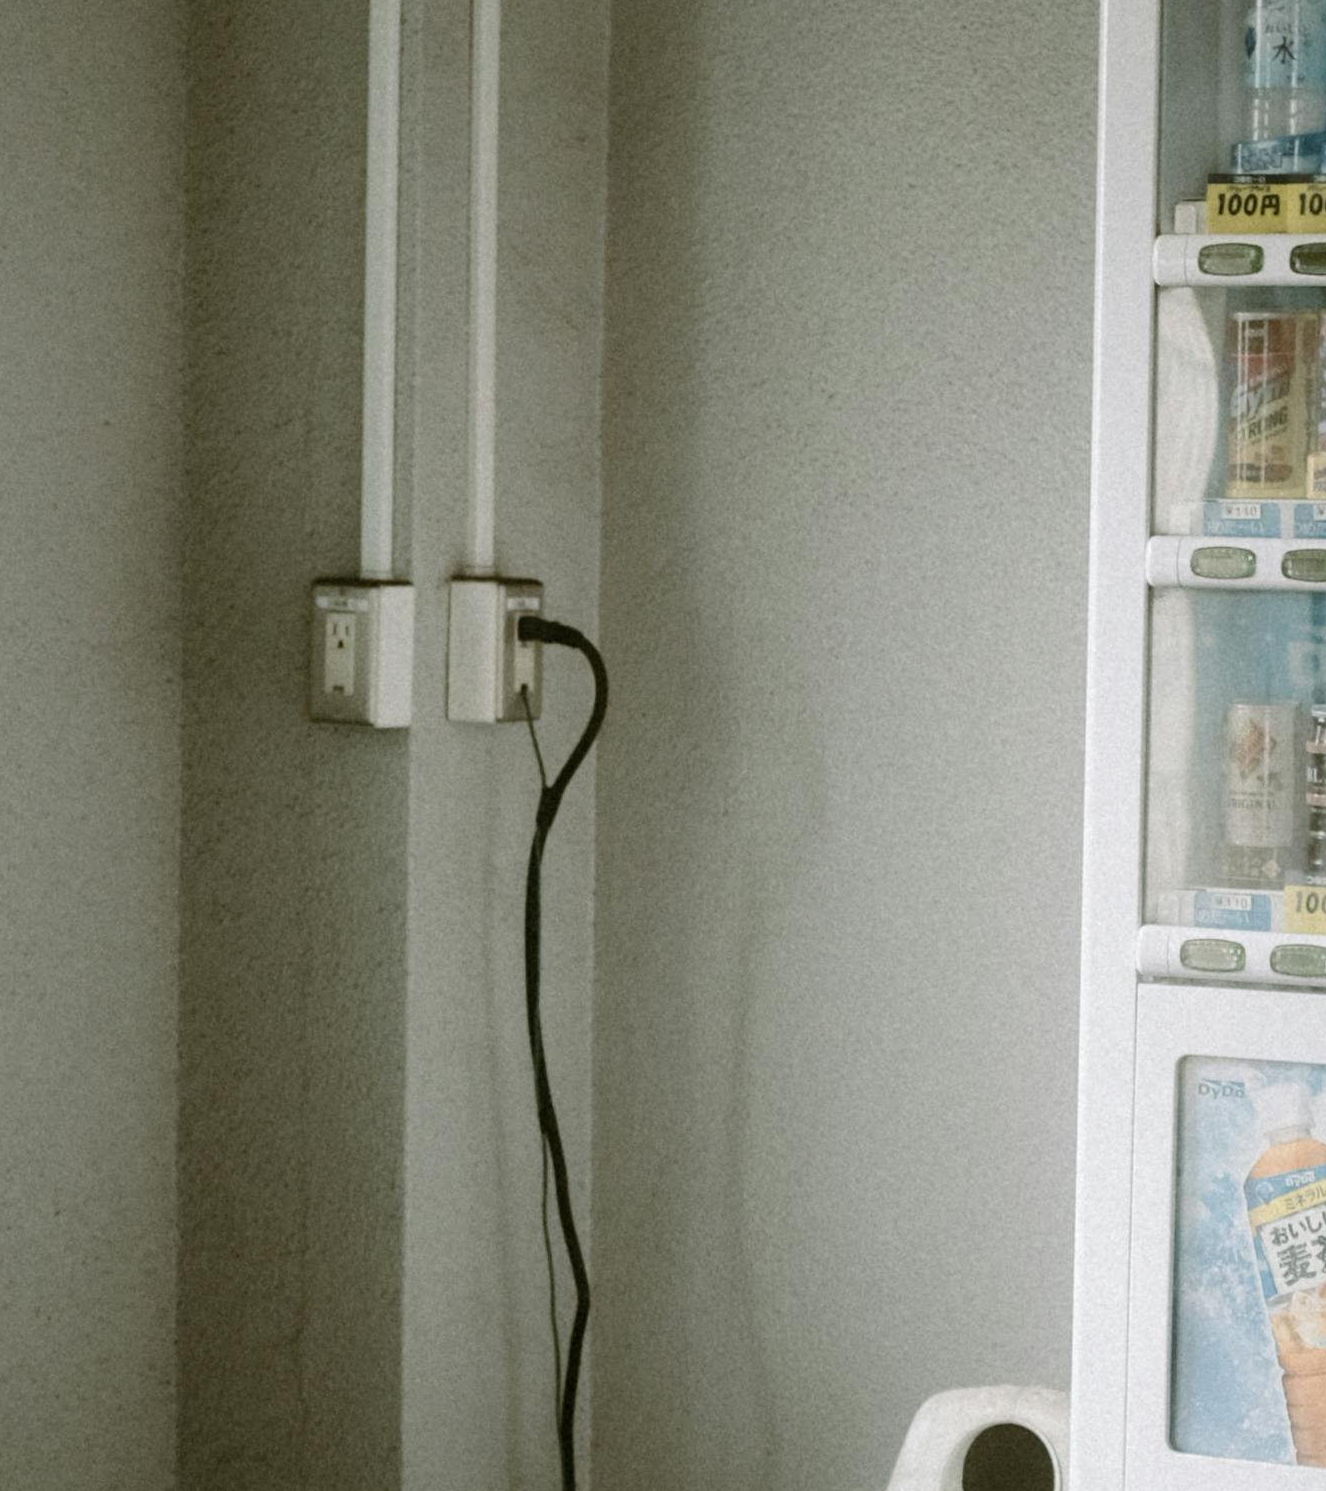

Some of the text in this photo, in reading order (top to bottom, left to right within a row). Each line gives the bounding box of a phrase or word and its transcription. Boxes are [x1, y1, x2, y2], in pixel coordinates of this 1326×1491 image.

[1272, 35, 1296, 65] 水
[1218, 193, 1280, 216] 100円
[1198, 1078, 1246, 1100] DyDo
